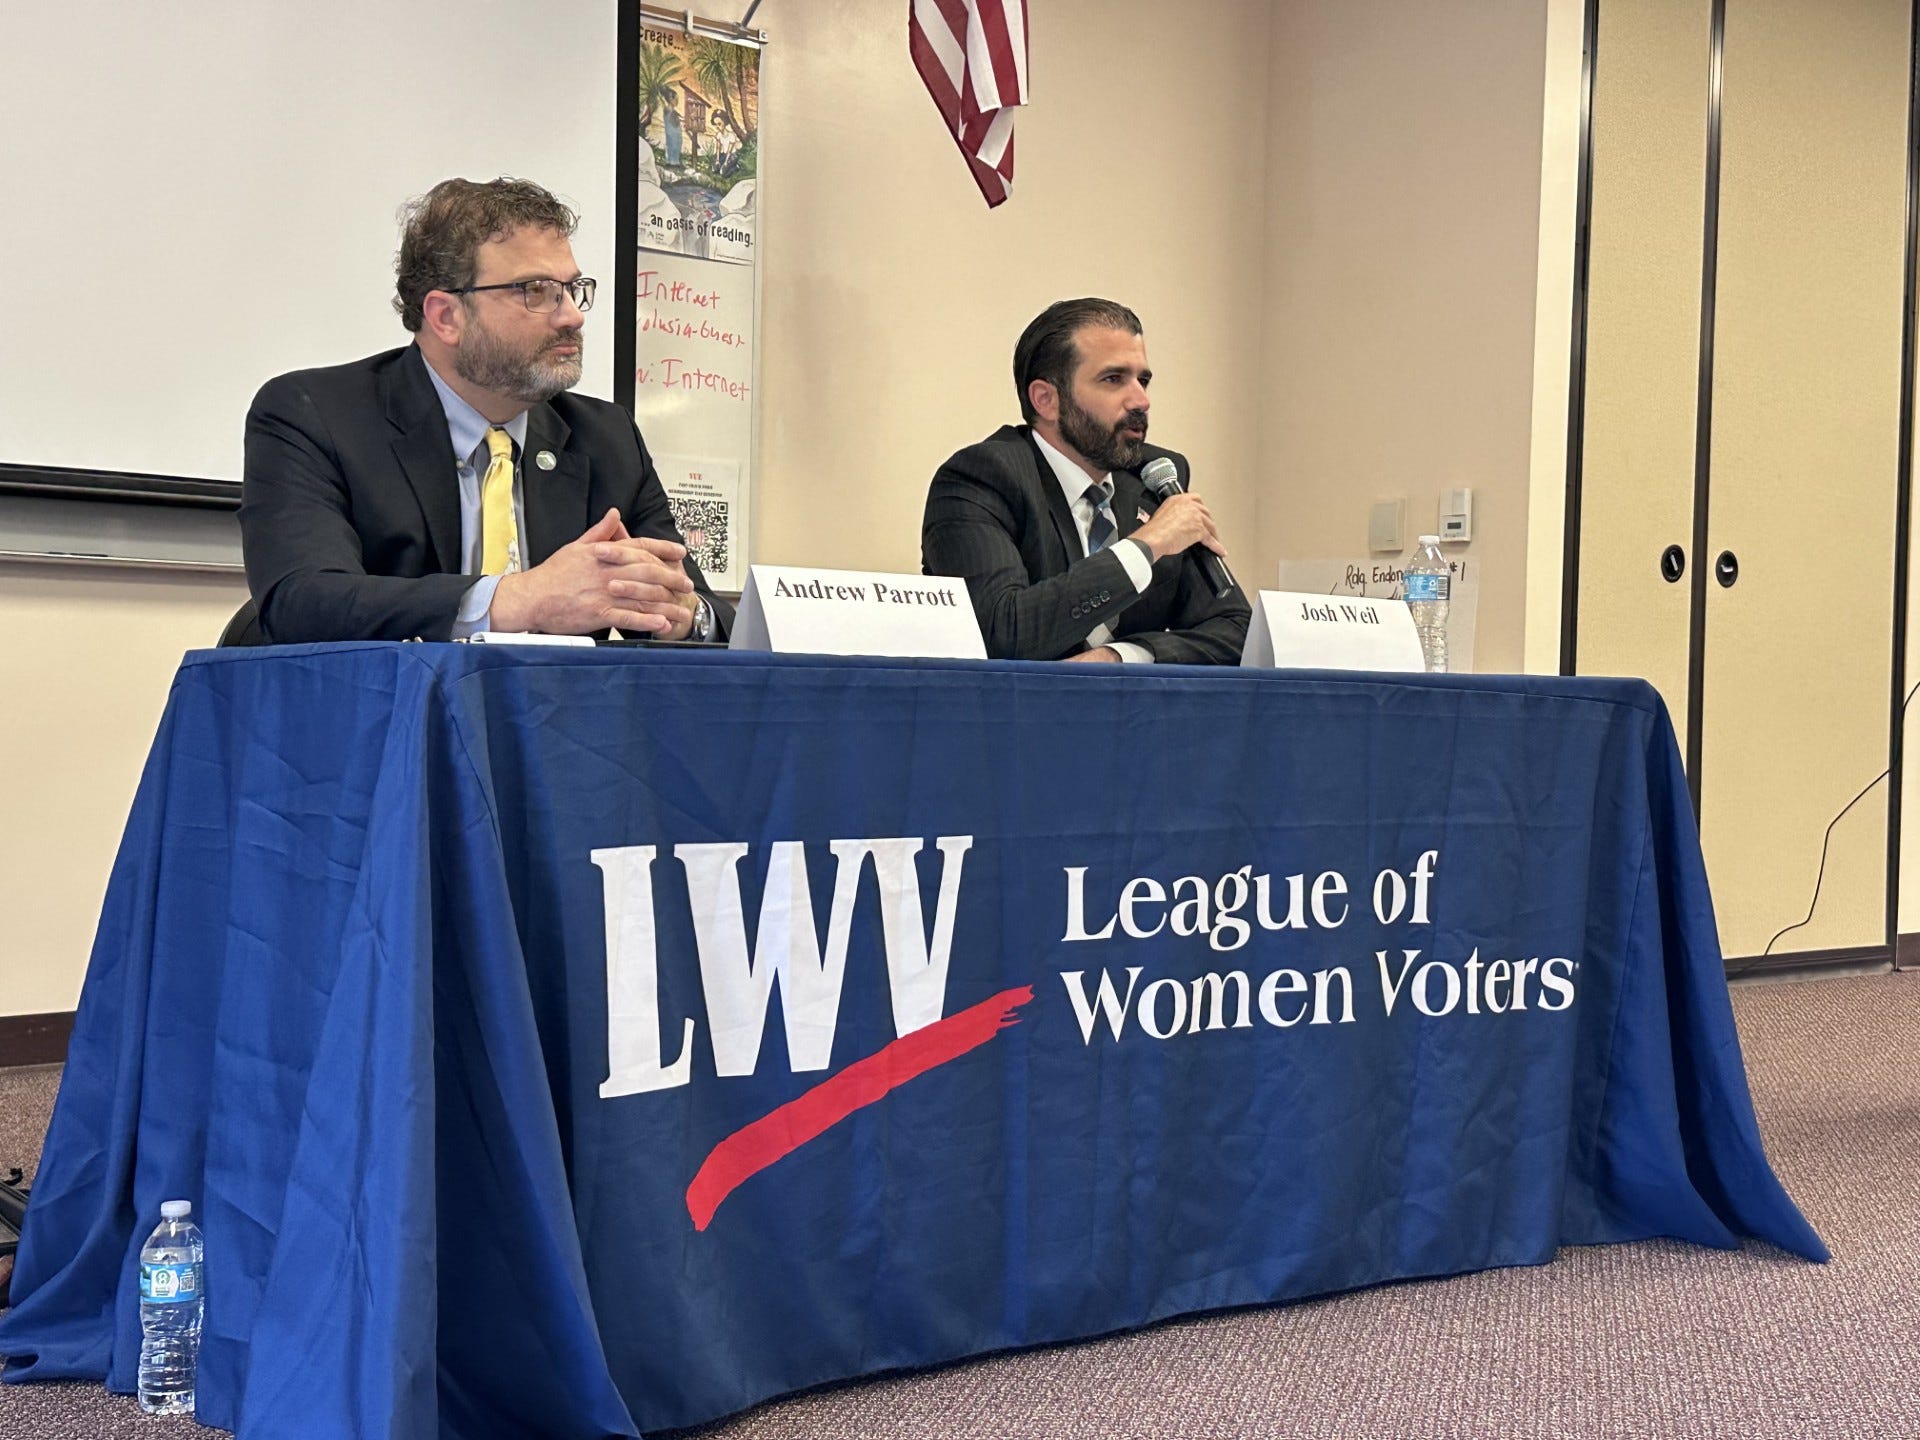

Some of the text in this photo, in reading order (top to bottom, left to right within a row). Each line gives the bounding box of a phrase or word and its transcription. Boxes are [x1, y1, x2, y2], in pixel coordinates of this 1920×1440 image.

[666, 218, 694, 231] oasis
[697, 221, 708, 236] of
[711, 225, 753, 247] reading.
[637, 271, 720, 309] Internet
[638, 308, 745, 347] olusia-Guest
[661, 358, 750, 401] Internet
[774, 577, 957, 606] Andrew Parrott
[1301, 603, 1380, 625] Josh Weil
[1061, 850, 1438, 951] League of
[591, 835, 973, 1099] LWV
[1060, 946, 1575, 1047] Women Voters
